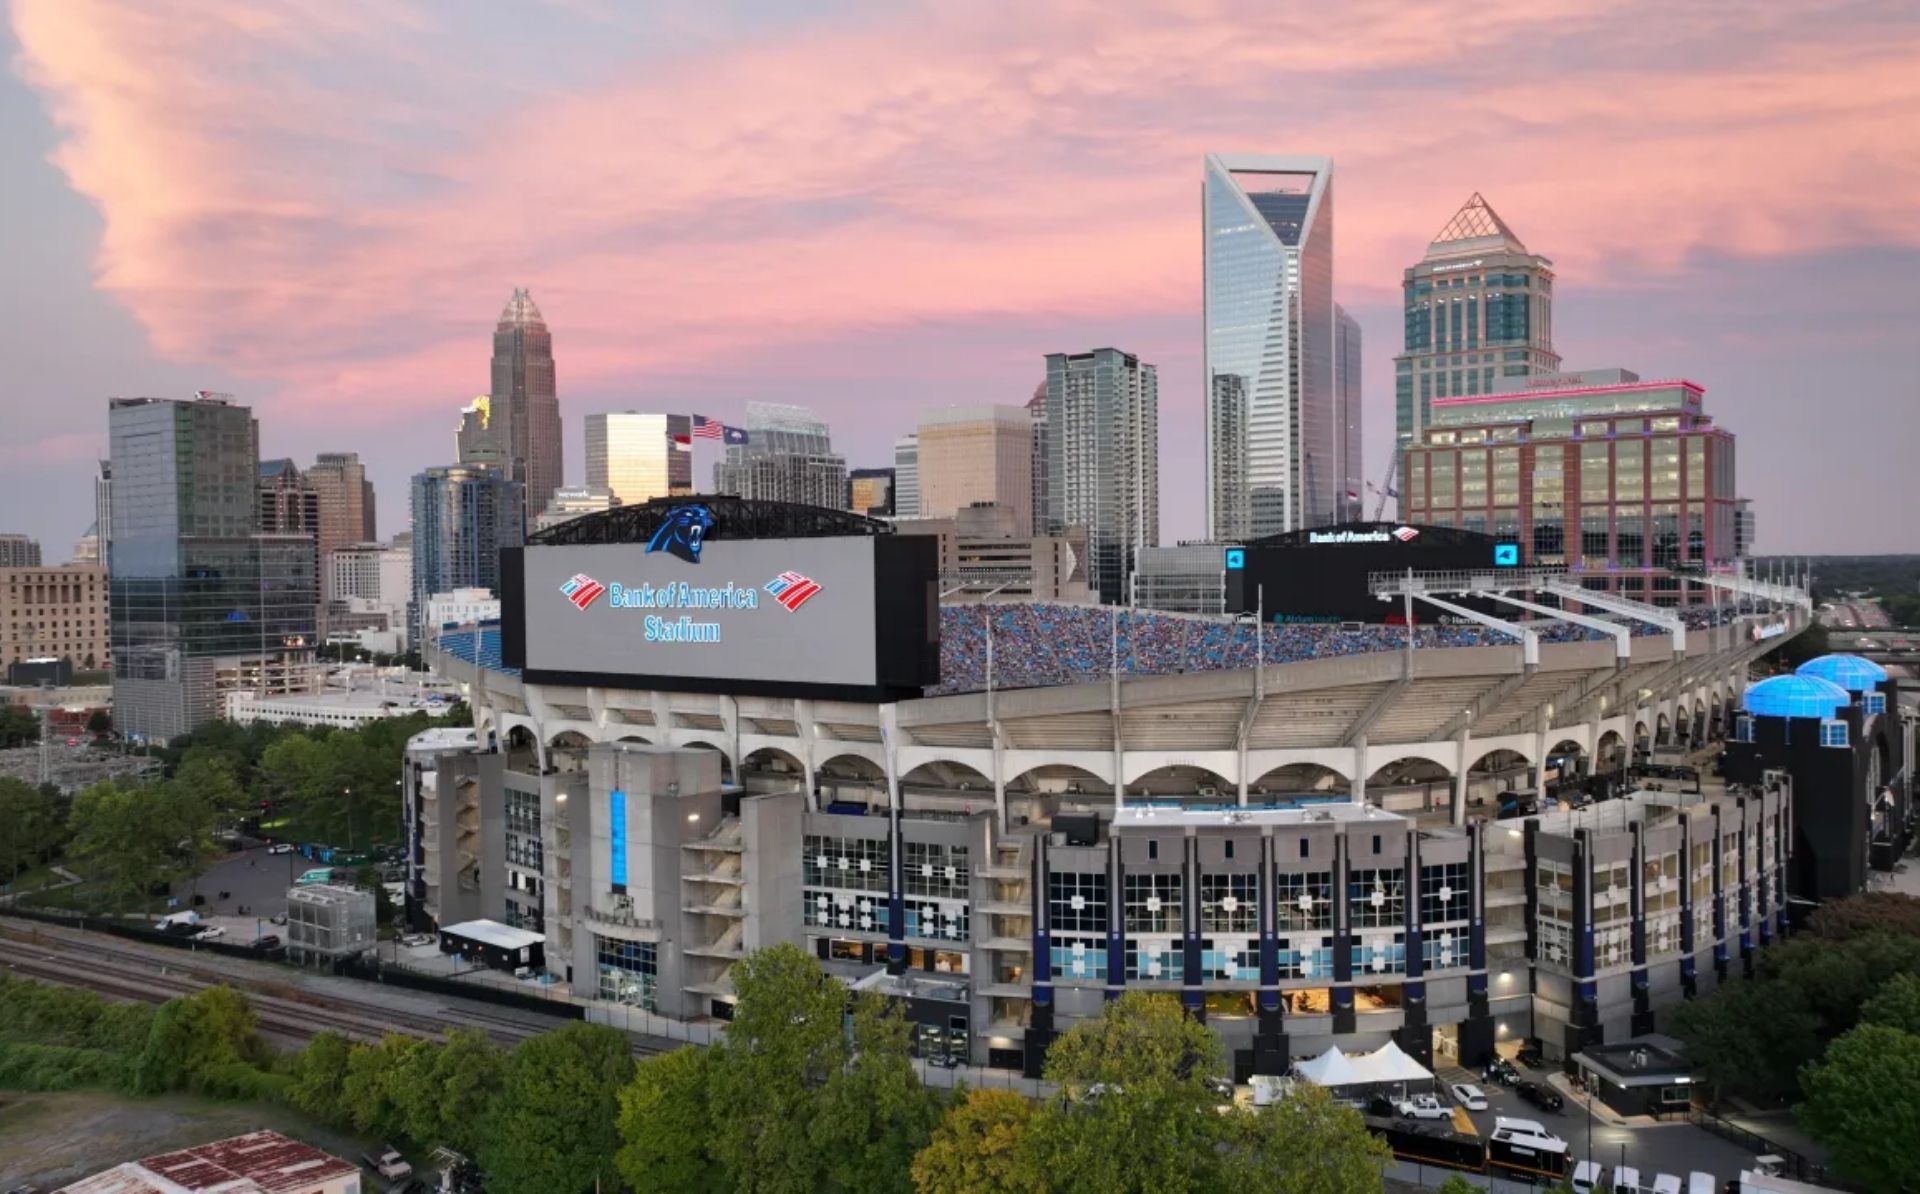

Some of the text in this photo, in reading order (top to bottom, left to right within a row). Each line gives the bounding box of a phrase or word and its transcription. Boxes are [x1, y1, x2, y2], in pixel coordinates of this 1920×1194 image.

[1310, 530, 1390, 543] Bank of America
[610, 581, 759, 609] Bank of America
[644, 615, 721, 642] Stadium
